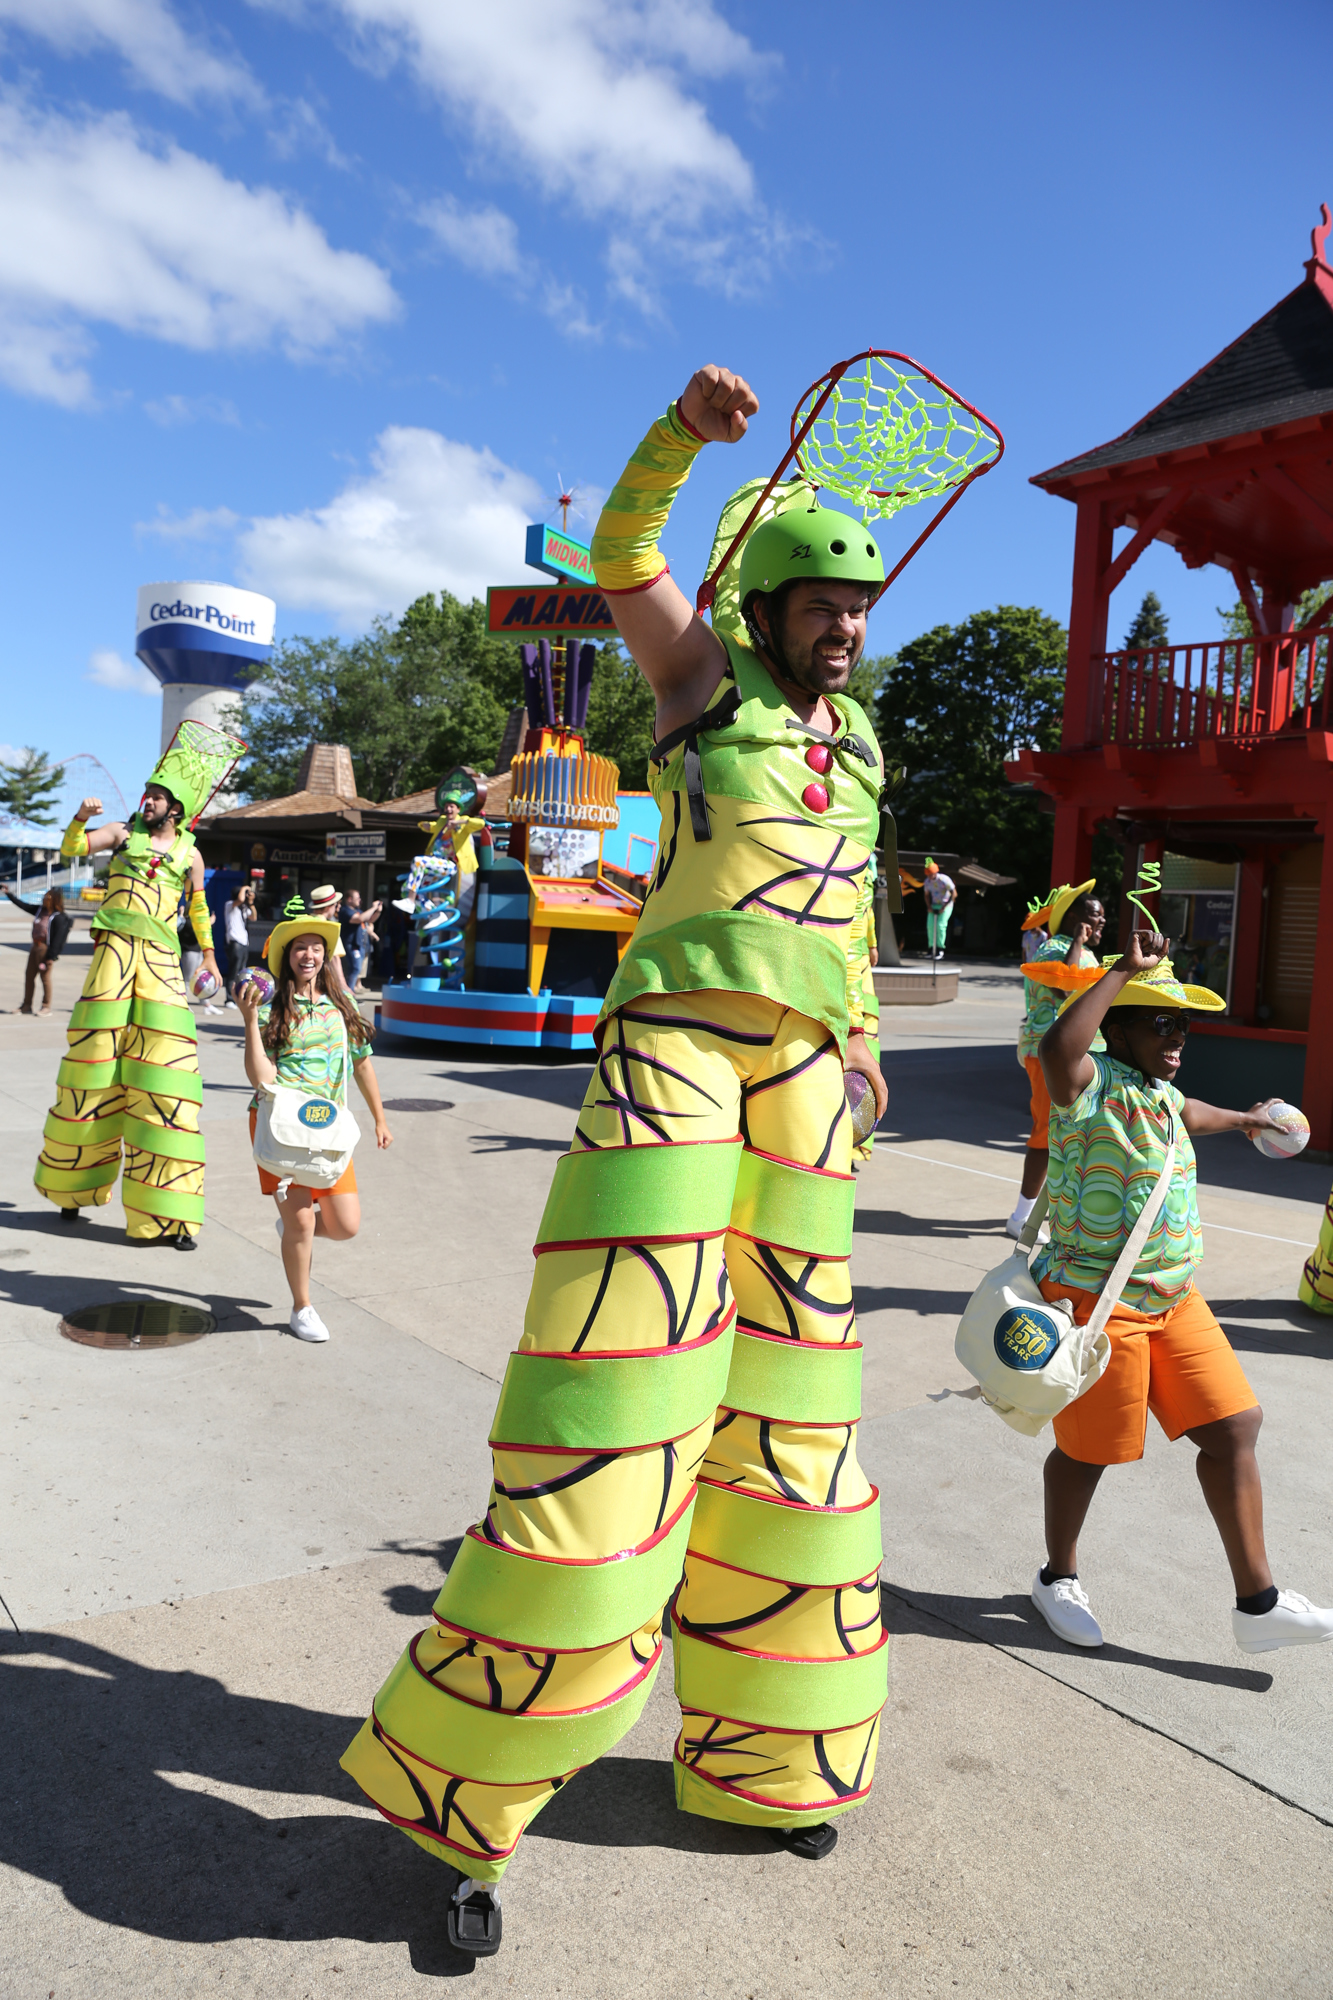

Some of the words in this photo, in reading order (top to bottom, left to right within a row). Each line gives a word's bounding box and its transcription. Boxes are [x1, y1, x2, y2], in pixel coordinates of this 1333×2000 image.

[788, 544, 812, 561] S1
[501, 593, 613, 626] MANIA
[508, 799, 620, 824] FASCINATION
[1206, 900, 1232, 909] Cedar
[305, 1106, 331, 1119] 150
[1003, 1334, 1031, 1361] YEARS
[1005, 1316, 1047, 1356] 150
